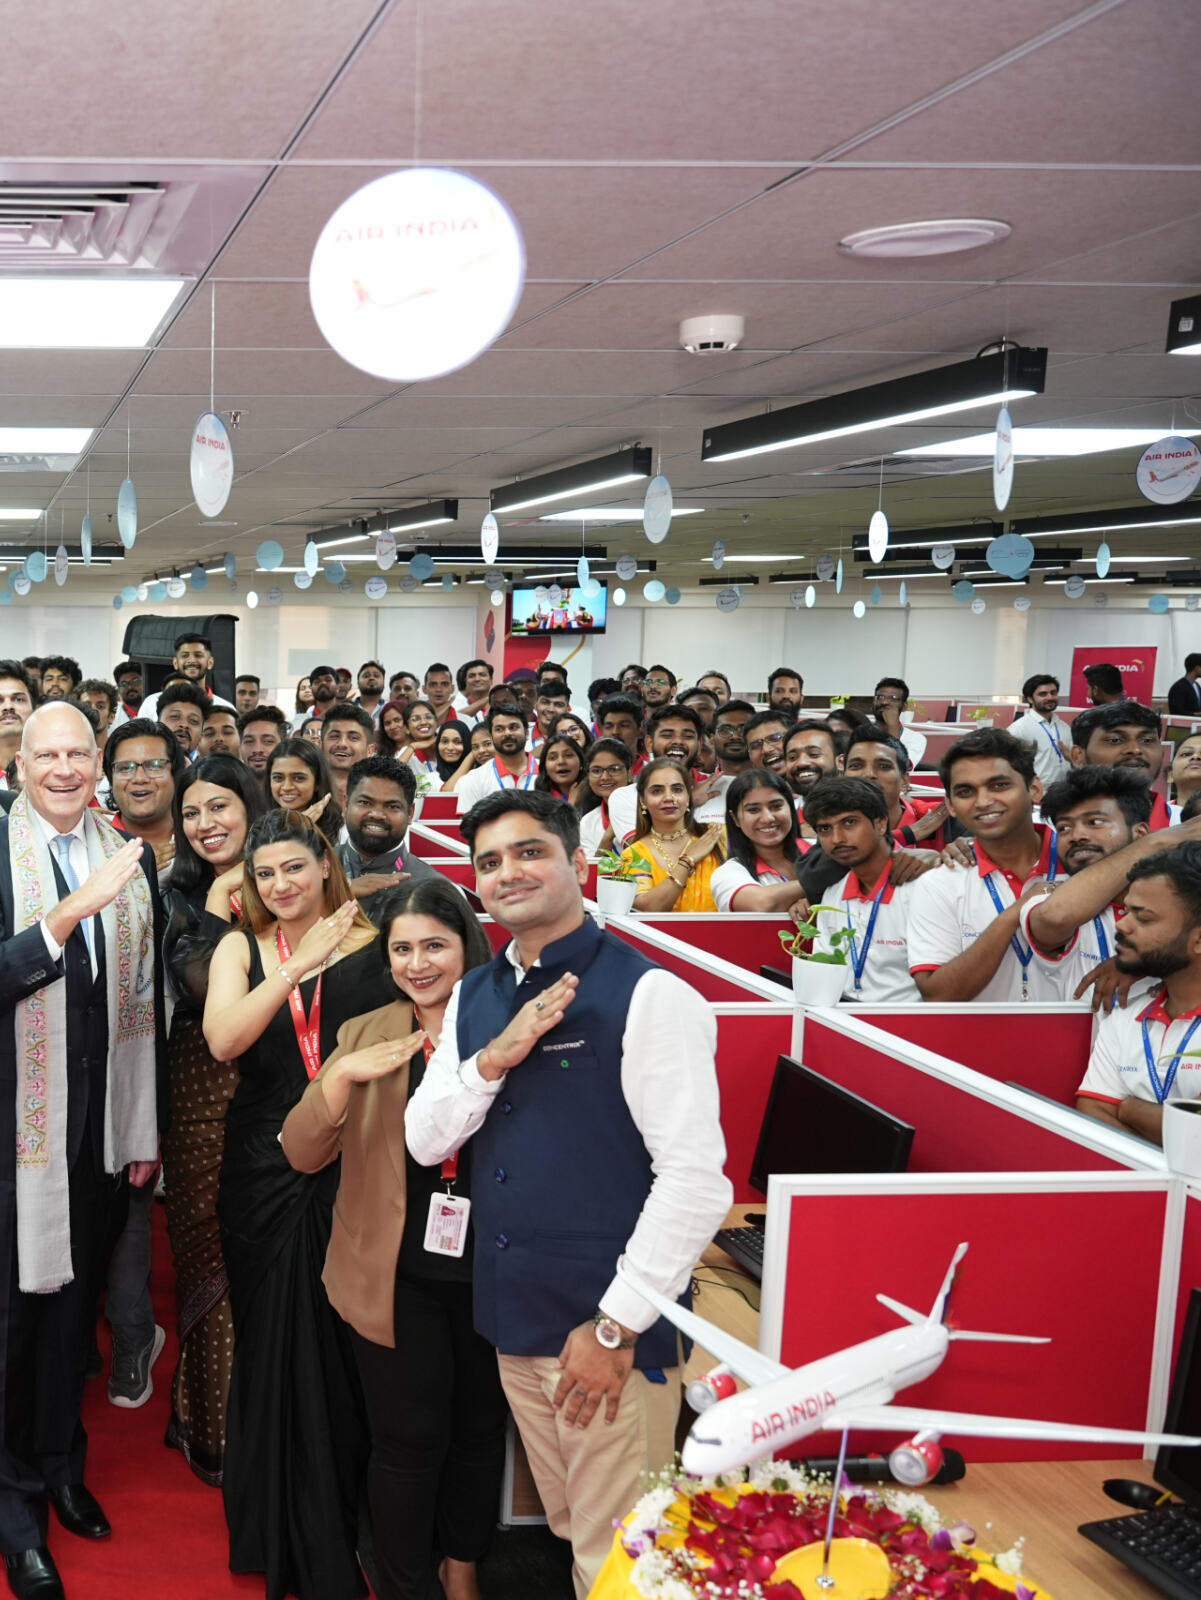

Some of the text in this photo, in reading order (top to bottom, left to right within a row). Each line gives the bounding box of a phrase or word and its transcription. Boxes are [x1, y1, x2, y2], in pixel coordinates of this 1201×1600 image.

[196, 434, 226, 451] AIR INDIA
[1165, 451, 1192, 460] INDIA
[751, 1390, 837, 1444] AIR INDIA
